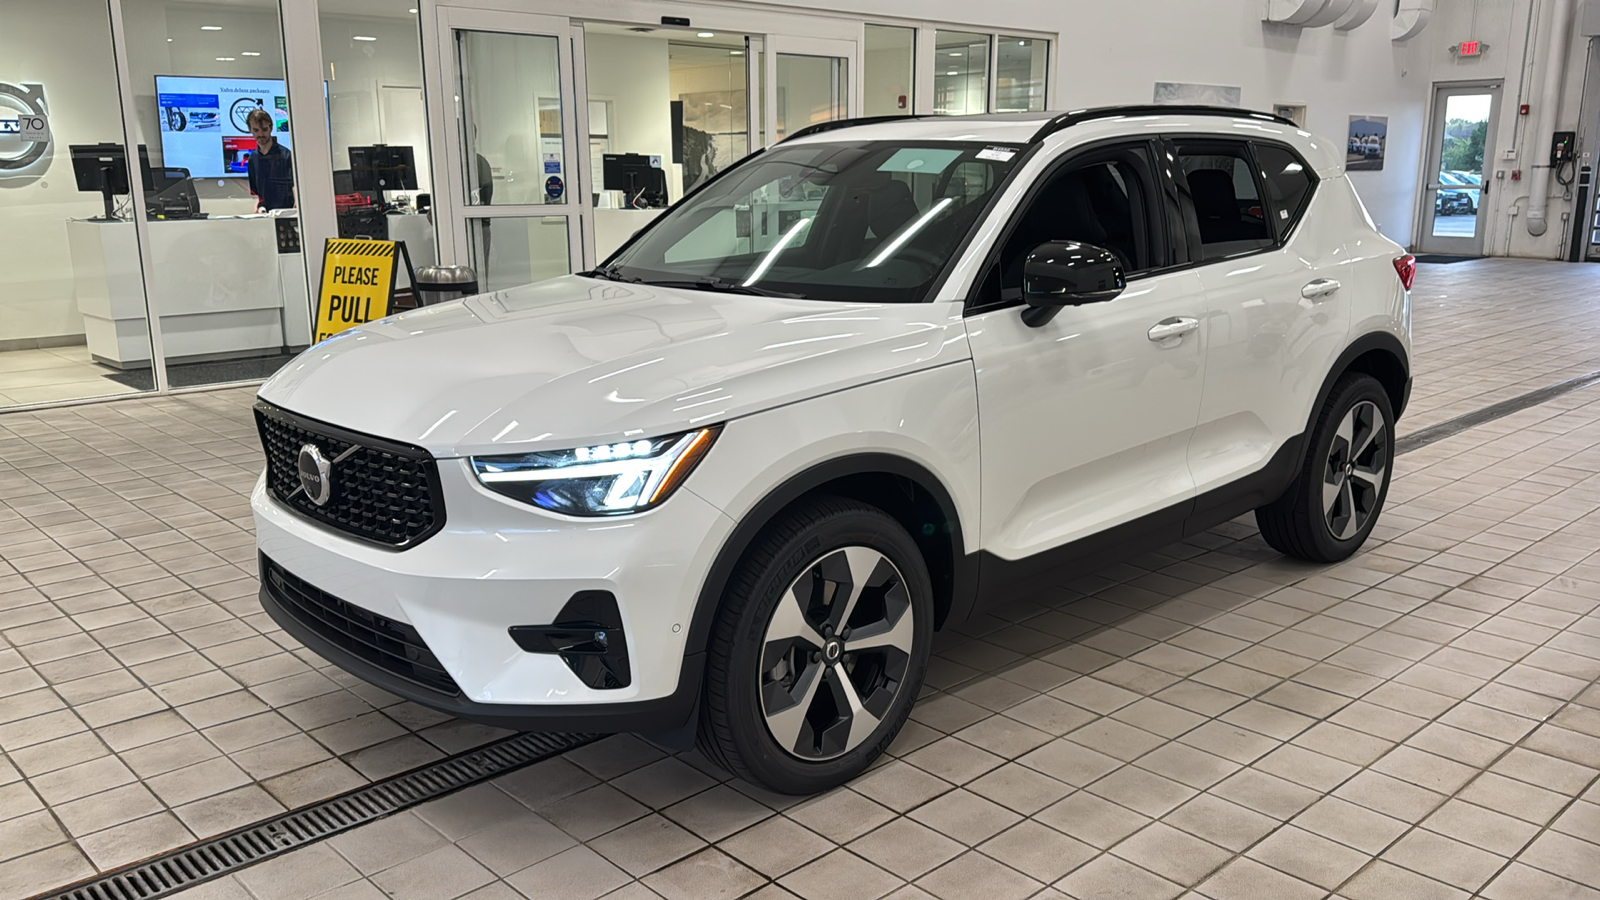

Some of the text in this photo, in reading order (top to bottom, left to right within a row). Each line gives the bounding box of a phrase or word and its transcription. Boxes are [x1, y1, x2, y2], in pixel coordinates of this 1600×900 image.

[1461, 41, 1478, 55] EXIT
[22, 117, 44, 130] 70
[333, 266, 379, 286] PLEASE
[328, 295, 371, 324] PULL
[300, 469, 320, 483] VOLVO
